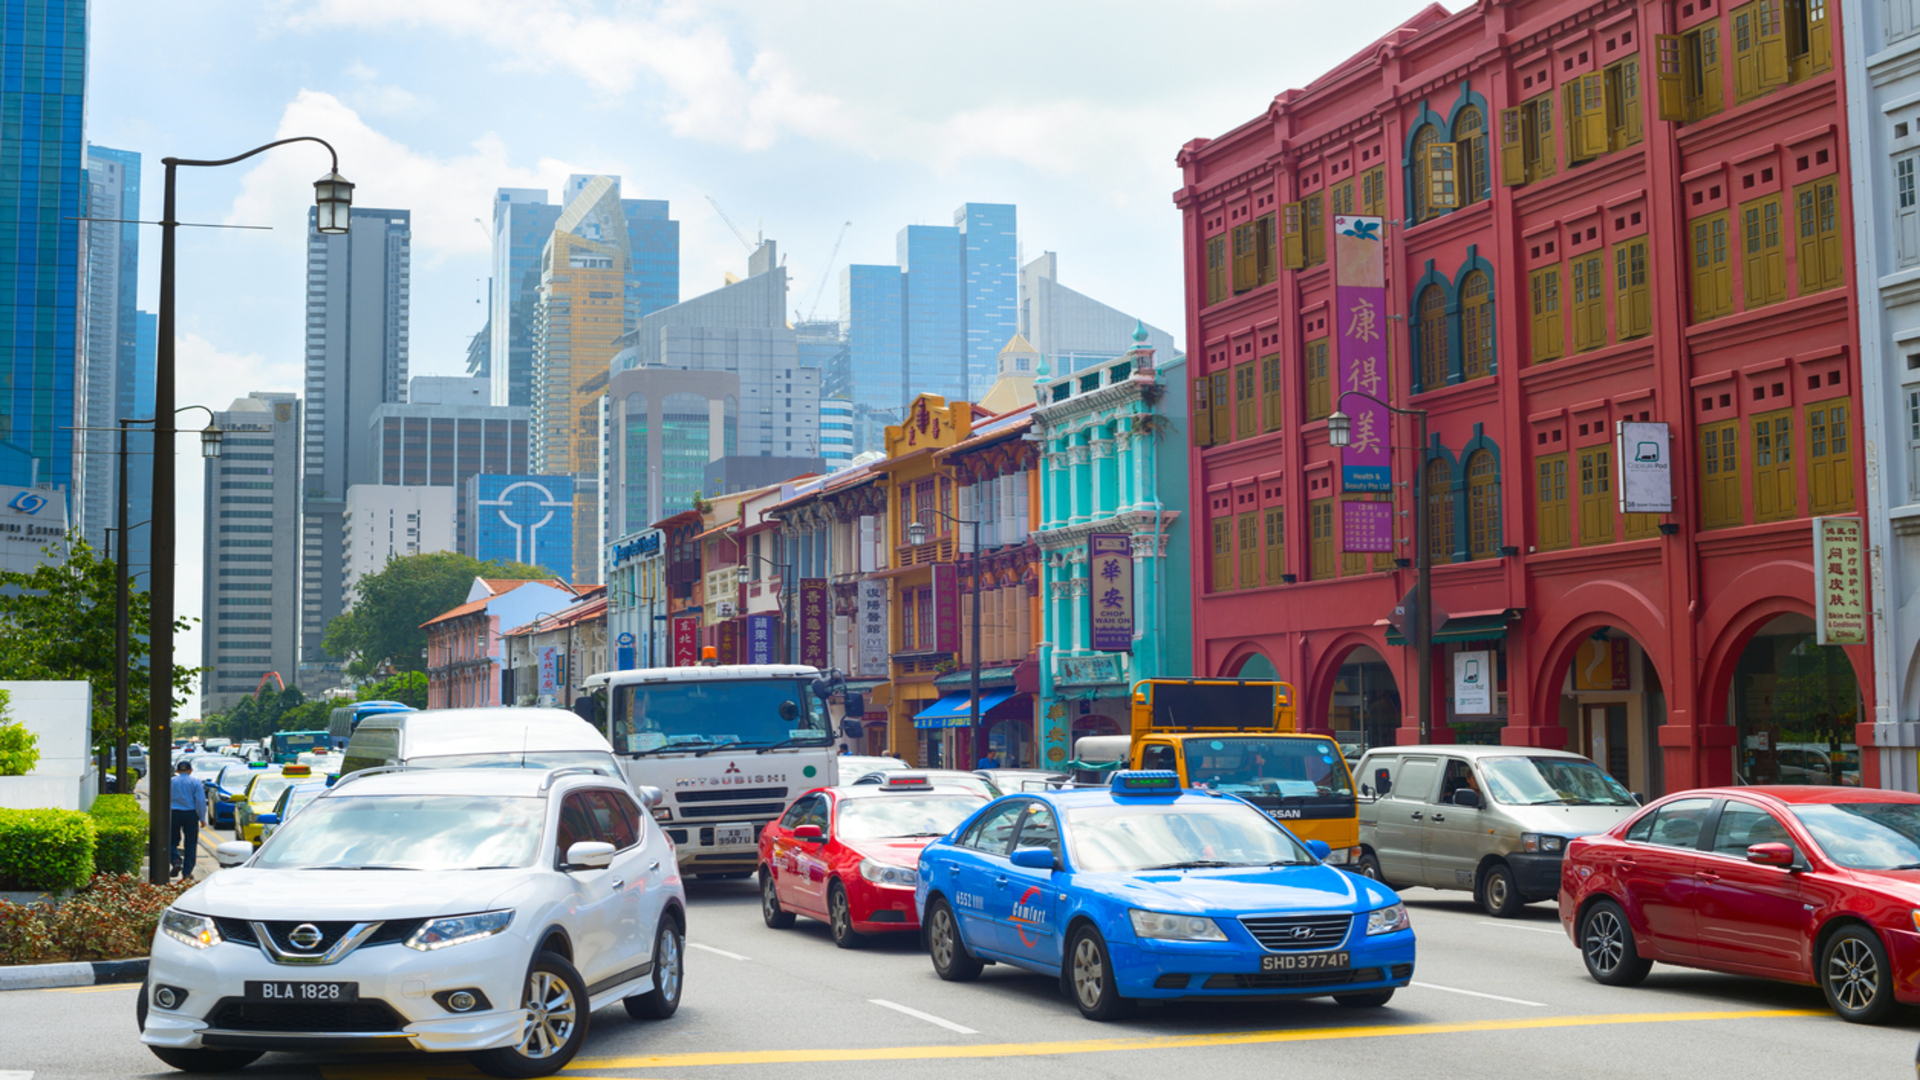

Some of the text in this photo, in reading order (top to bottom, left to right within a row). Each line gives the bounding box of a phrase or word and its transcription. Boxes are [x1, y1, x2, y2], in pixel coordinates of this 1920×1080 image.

[1345, 297, 1381, 455] 康得美
[1100, 558, 1124, 609] 華安
[1827, 547, 1846, 607] 问题皮肤
[1835, 630, 1856, 638] Clinic
[676, 774, 787, 787] MITSUBISHI
[1266, 809, 1301, 818] SSAN
[1012, 901, 1046, 923] Comfort
[263, 983, 340, 999] BLA 1828
